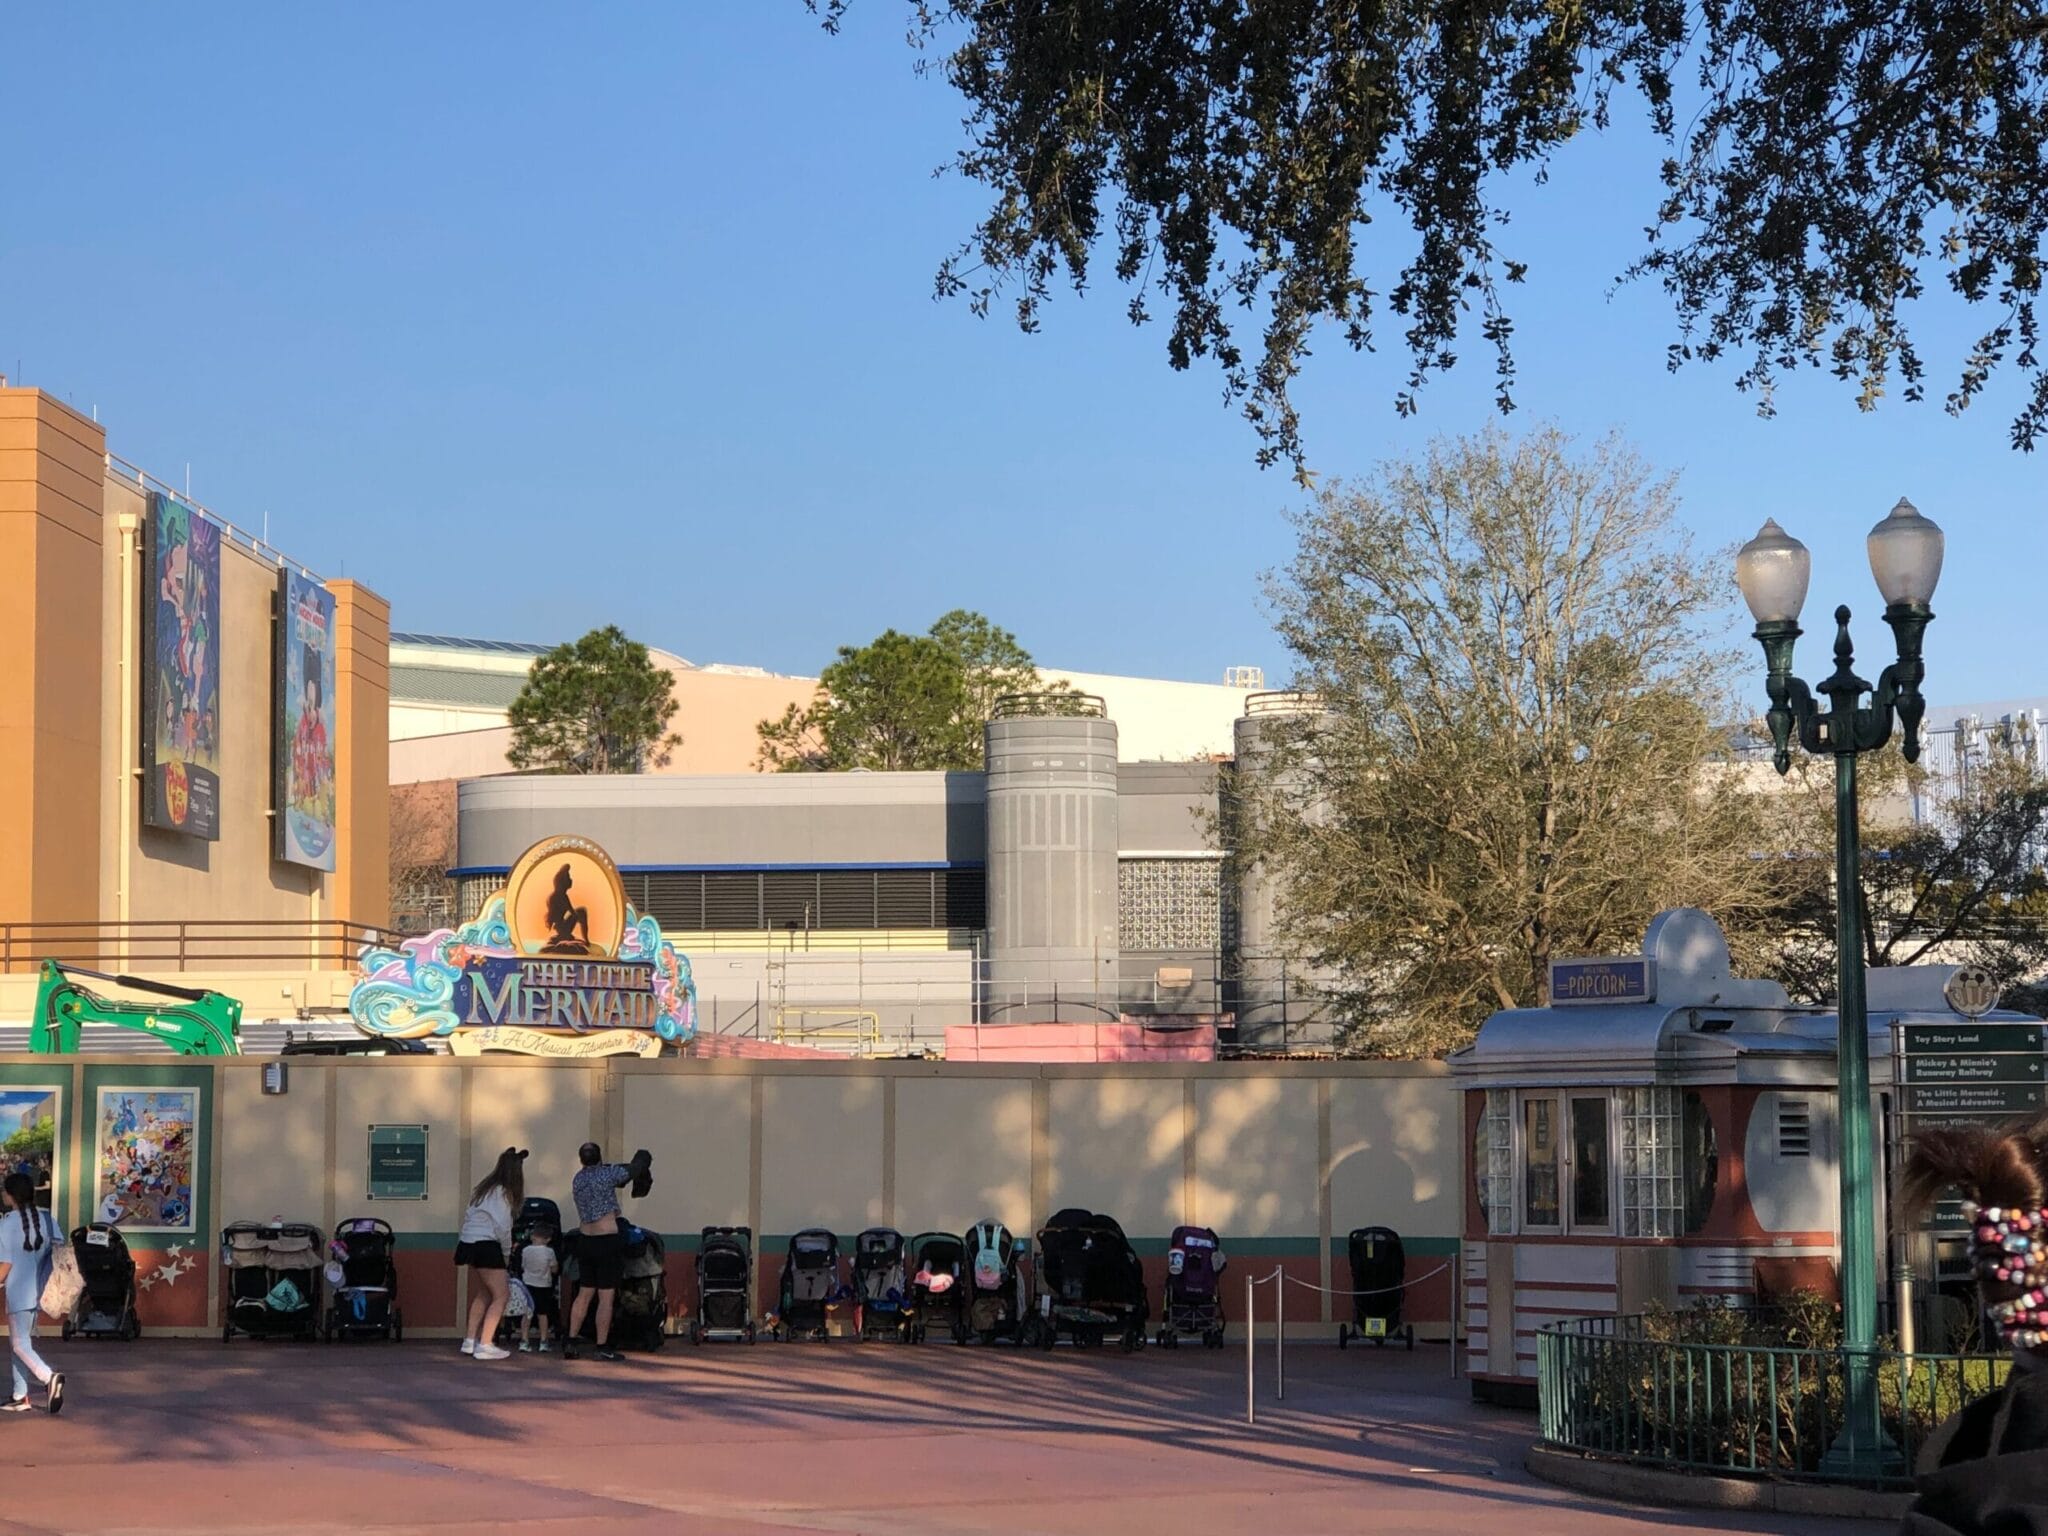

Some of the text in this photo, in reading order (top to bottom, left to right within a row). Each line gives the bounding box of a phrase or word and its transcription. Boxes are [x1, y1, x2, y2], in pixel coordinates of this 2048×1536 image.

[522, 961, 651, 989] THE LITTLE
[1568, 974, 1626, 996] POPCORN
[465, 972, 658, 1034] MERMAID
[502, 1029, 623, 1057] A Musical Adventure
[1915, 1034, 1980, 1044] Toy Story Land
[1916, 1059, 1997, 1068] Mickey & Minnie's
[1916, 1068, 1993, 1078] Runaway Railway
[1916, 1090, 1932, 1098] The
[1934, 1089, 1957, 1097] Little
[1960, 1088, 1999, 1097] Mermaid
[1925, 1099, 1958, 1107] Musical
